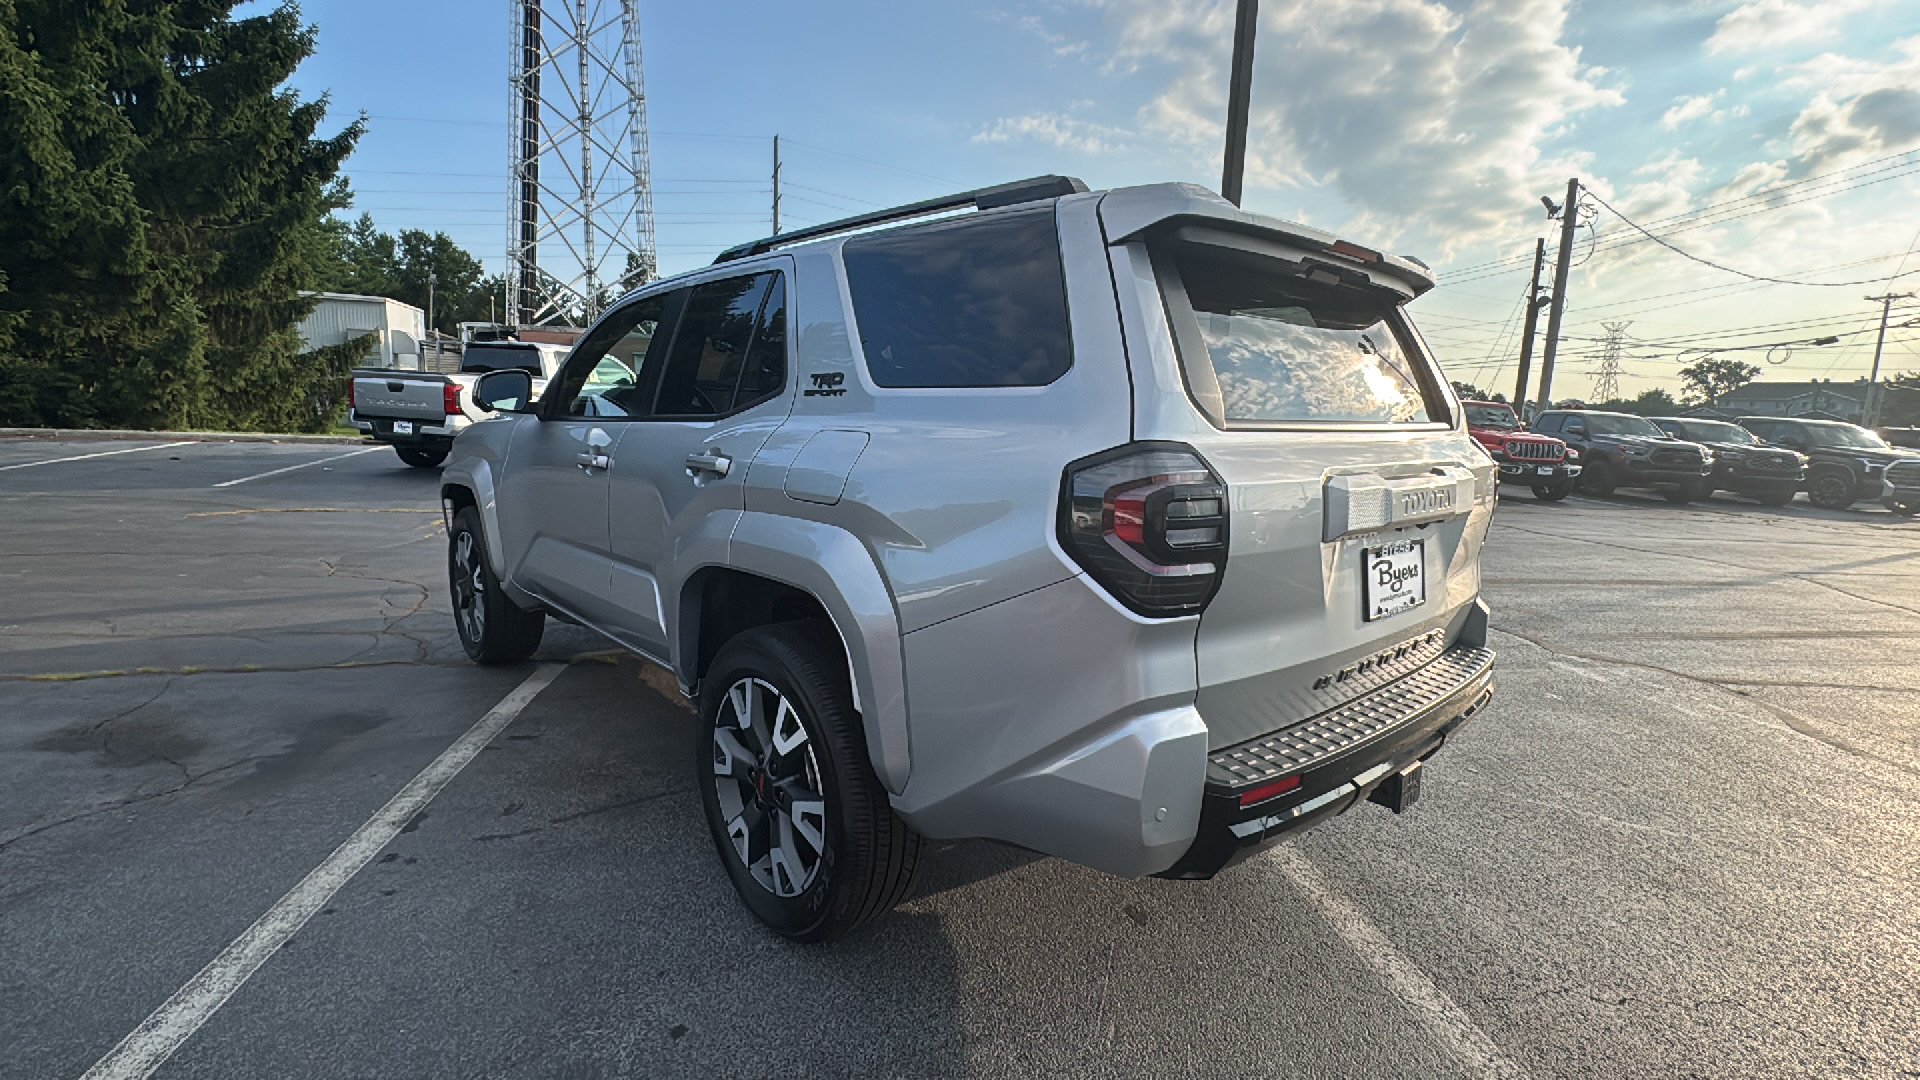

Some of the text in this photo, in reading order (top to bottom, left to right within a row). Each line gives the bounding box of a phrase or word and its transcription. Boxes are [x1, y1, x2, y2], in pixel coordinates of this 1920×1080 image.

[810, 372, 844, 389] TRD
[803, 389, 847, 397] SPORT
[1401, 489, 1451, 516] TOYOTA
[1371, 559, 1419, 592] Byers
